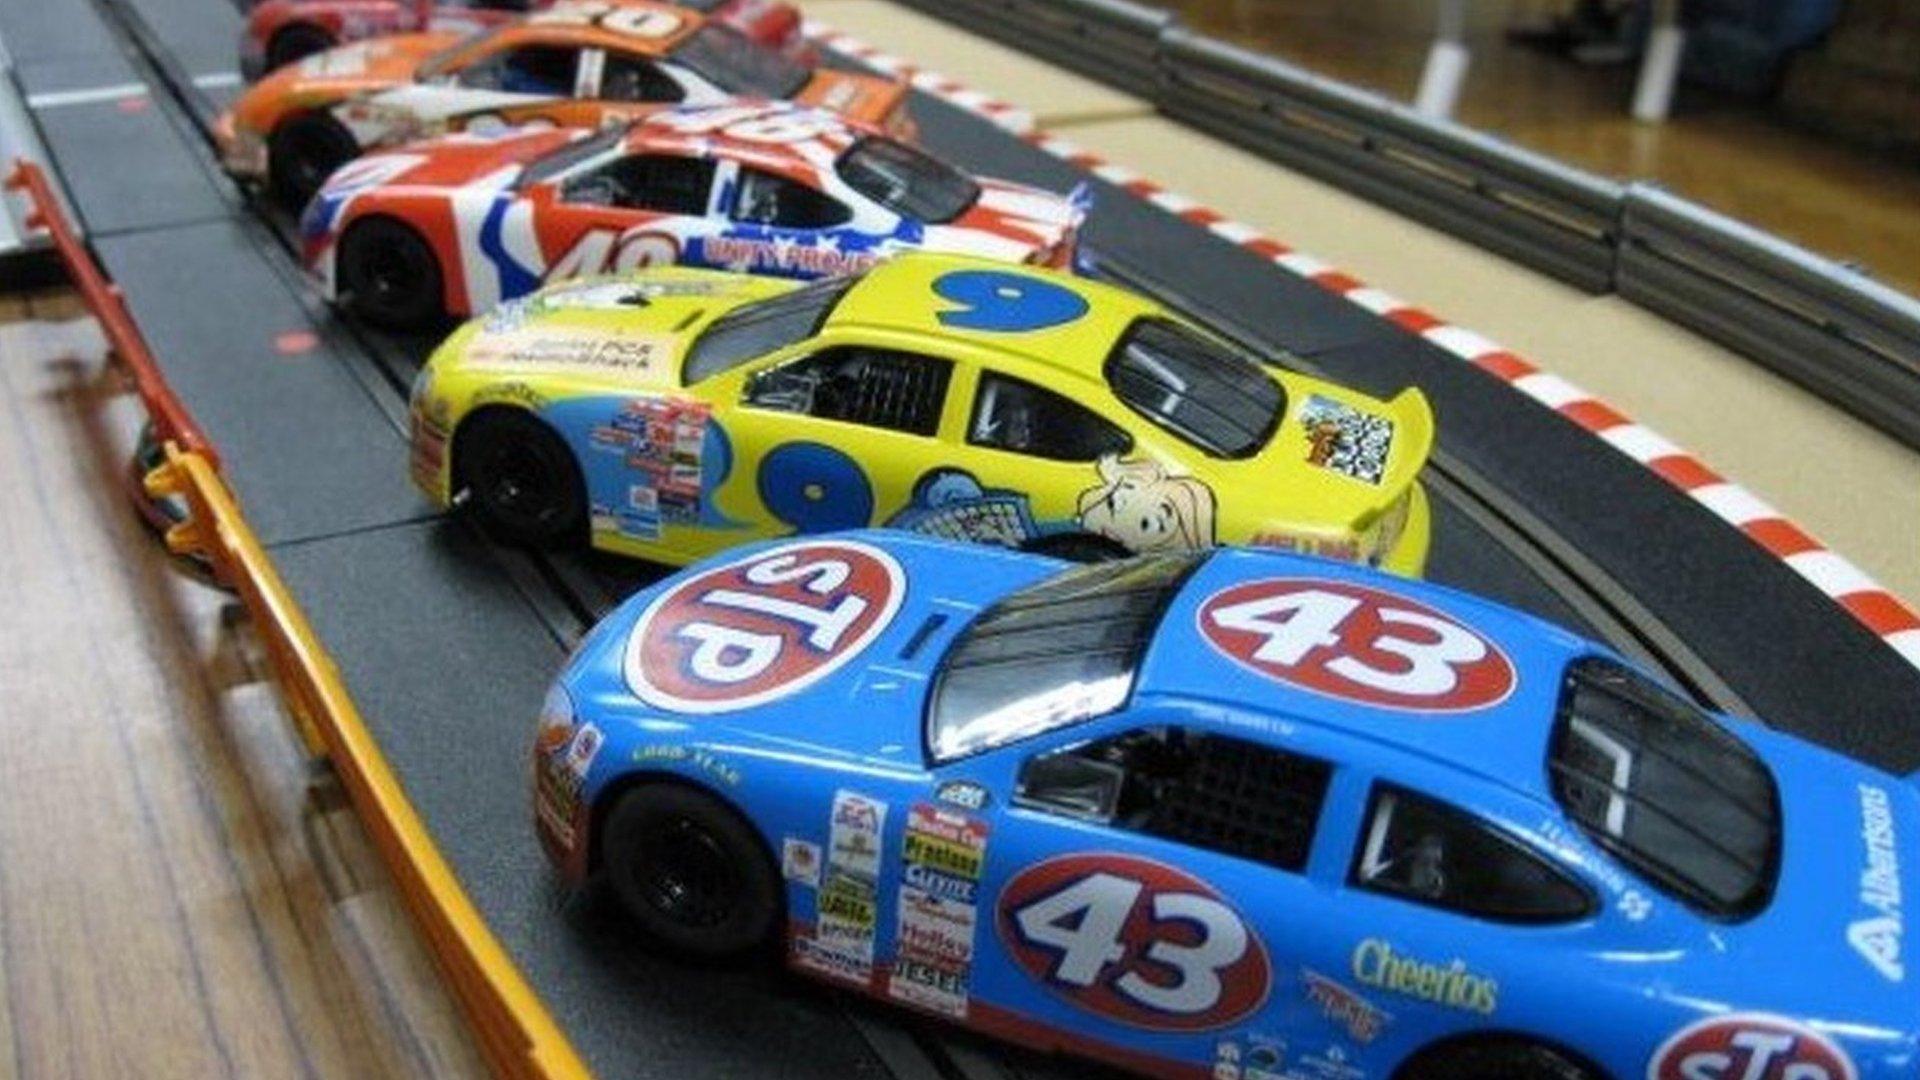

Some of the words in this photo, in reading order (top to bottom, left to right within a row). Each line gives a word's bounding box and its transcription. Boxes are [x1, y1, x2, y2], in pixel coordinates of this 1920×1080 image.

[677, 553, 869, 684] STP
[1211, 590, 1487, 695] 43
[1015, 872, 1248, 1014] 43
[1352, 936, 1498, 1015] Cheerios
